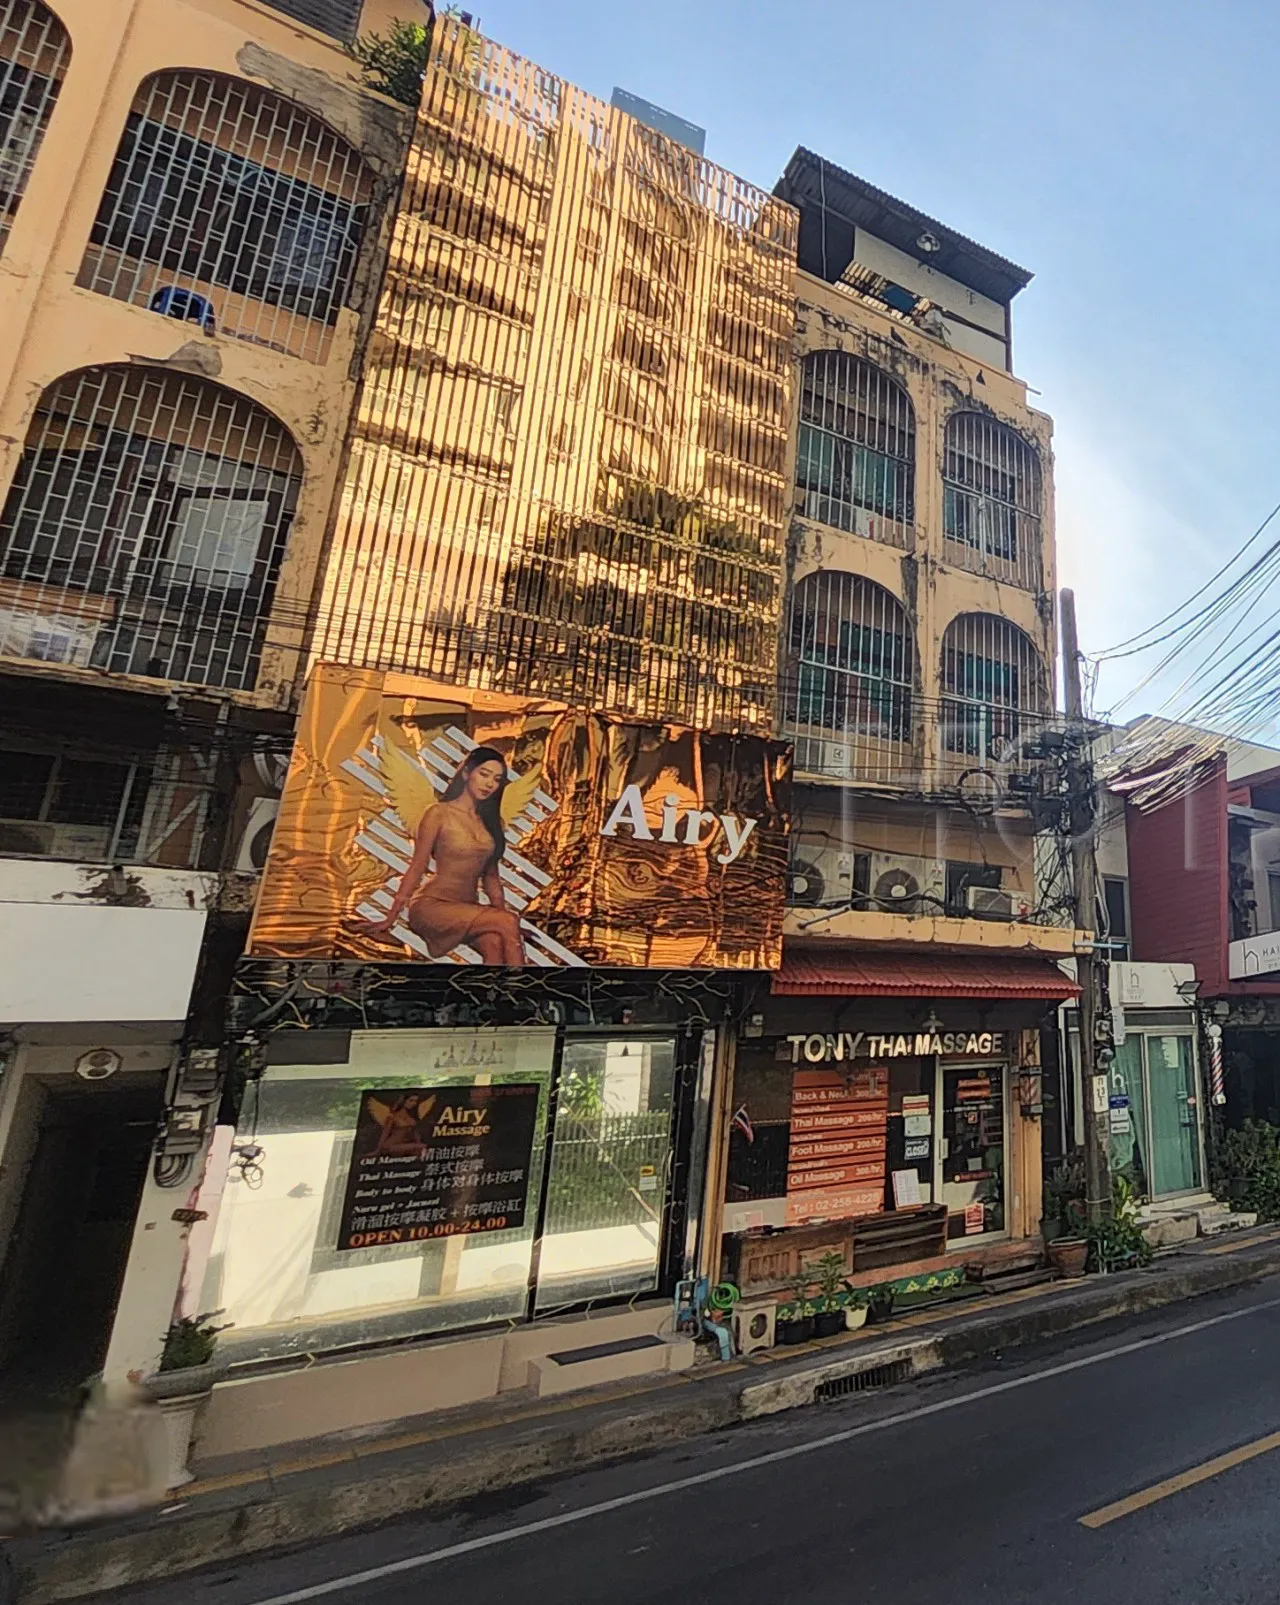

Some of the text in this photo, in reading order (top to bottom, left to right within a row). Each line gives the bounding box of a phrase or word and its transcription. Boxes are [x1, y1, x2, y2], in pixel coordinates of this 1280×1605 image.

[599, 784, 757, 864] Airy
[786, 1032, 1002, 1063] TONY THAI MASSAGE
[795, 1090, 817, 1101] Back
[819, 1090, 827, 1099] &
[438, 1106, 488, 1126] Airy
[794, 1118, 813, 1128] Thai
[815, 1115, 854, 1126] Massage
[432, 1124, 491, 1138] Massage
[791, 1145, 812, 1156] Foot
[815, 1142, 854, 1154] Massage
[378, 1155, 417, 1164] Massage
[359, 1159, 484, 1182] Thai Massage 泰式按摩
[790, 1174, 803, 1185] Oil
[804, 1170, 845, 1183] Massage
[420, 1169, 523, 1191] 身体对身体按摩
[793, 1203, 808, 1214] Tel
[350, 1216, 507, 1247] OPEN 10.00-24.00
